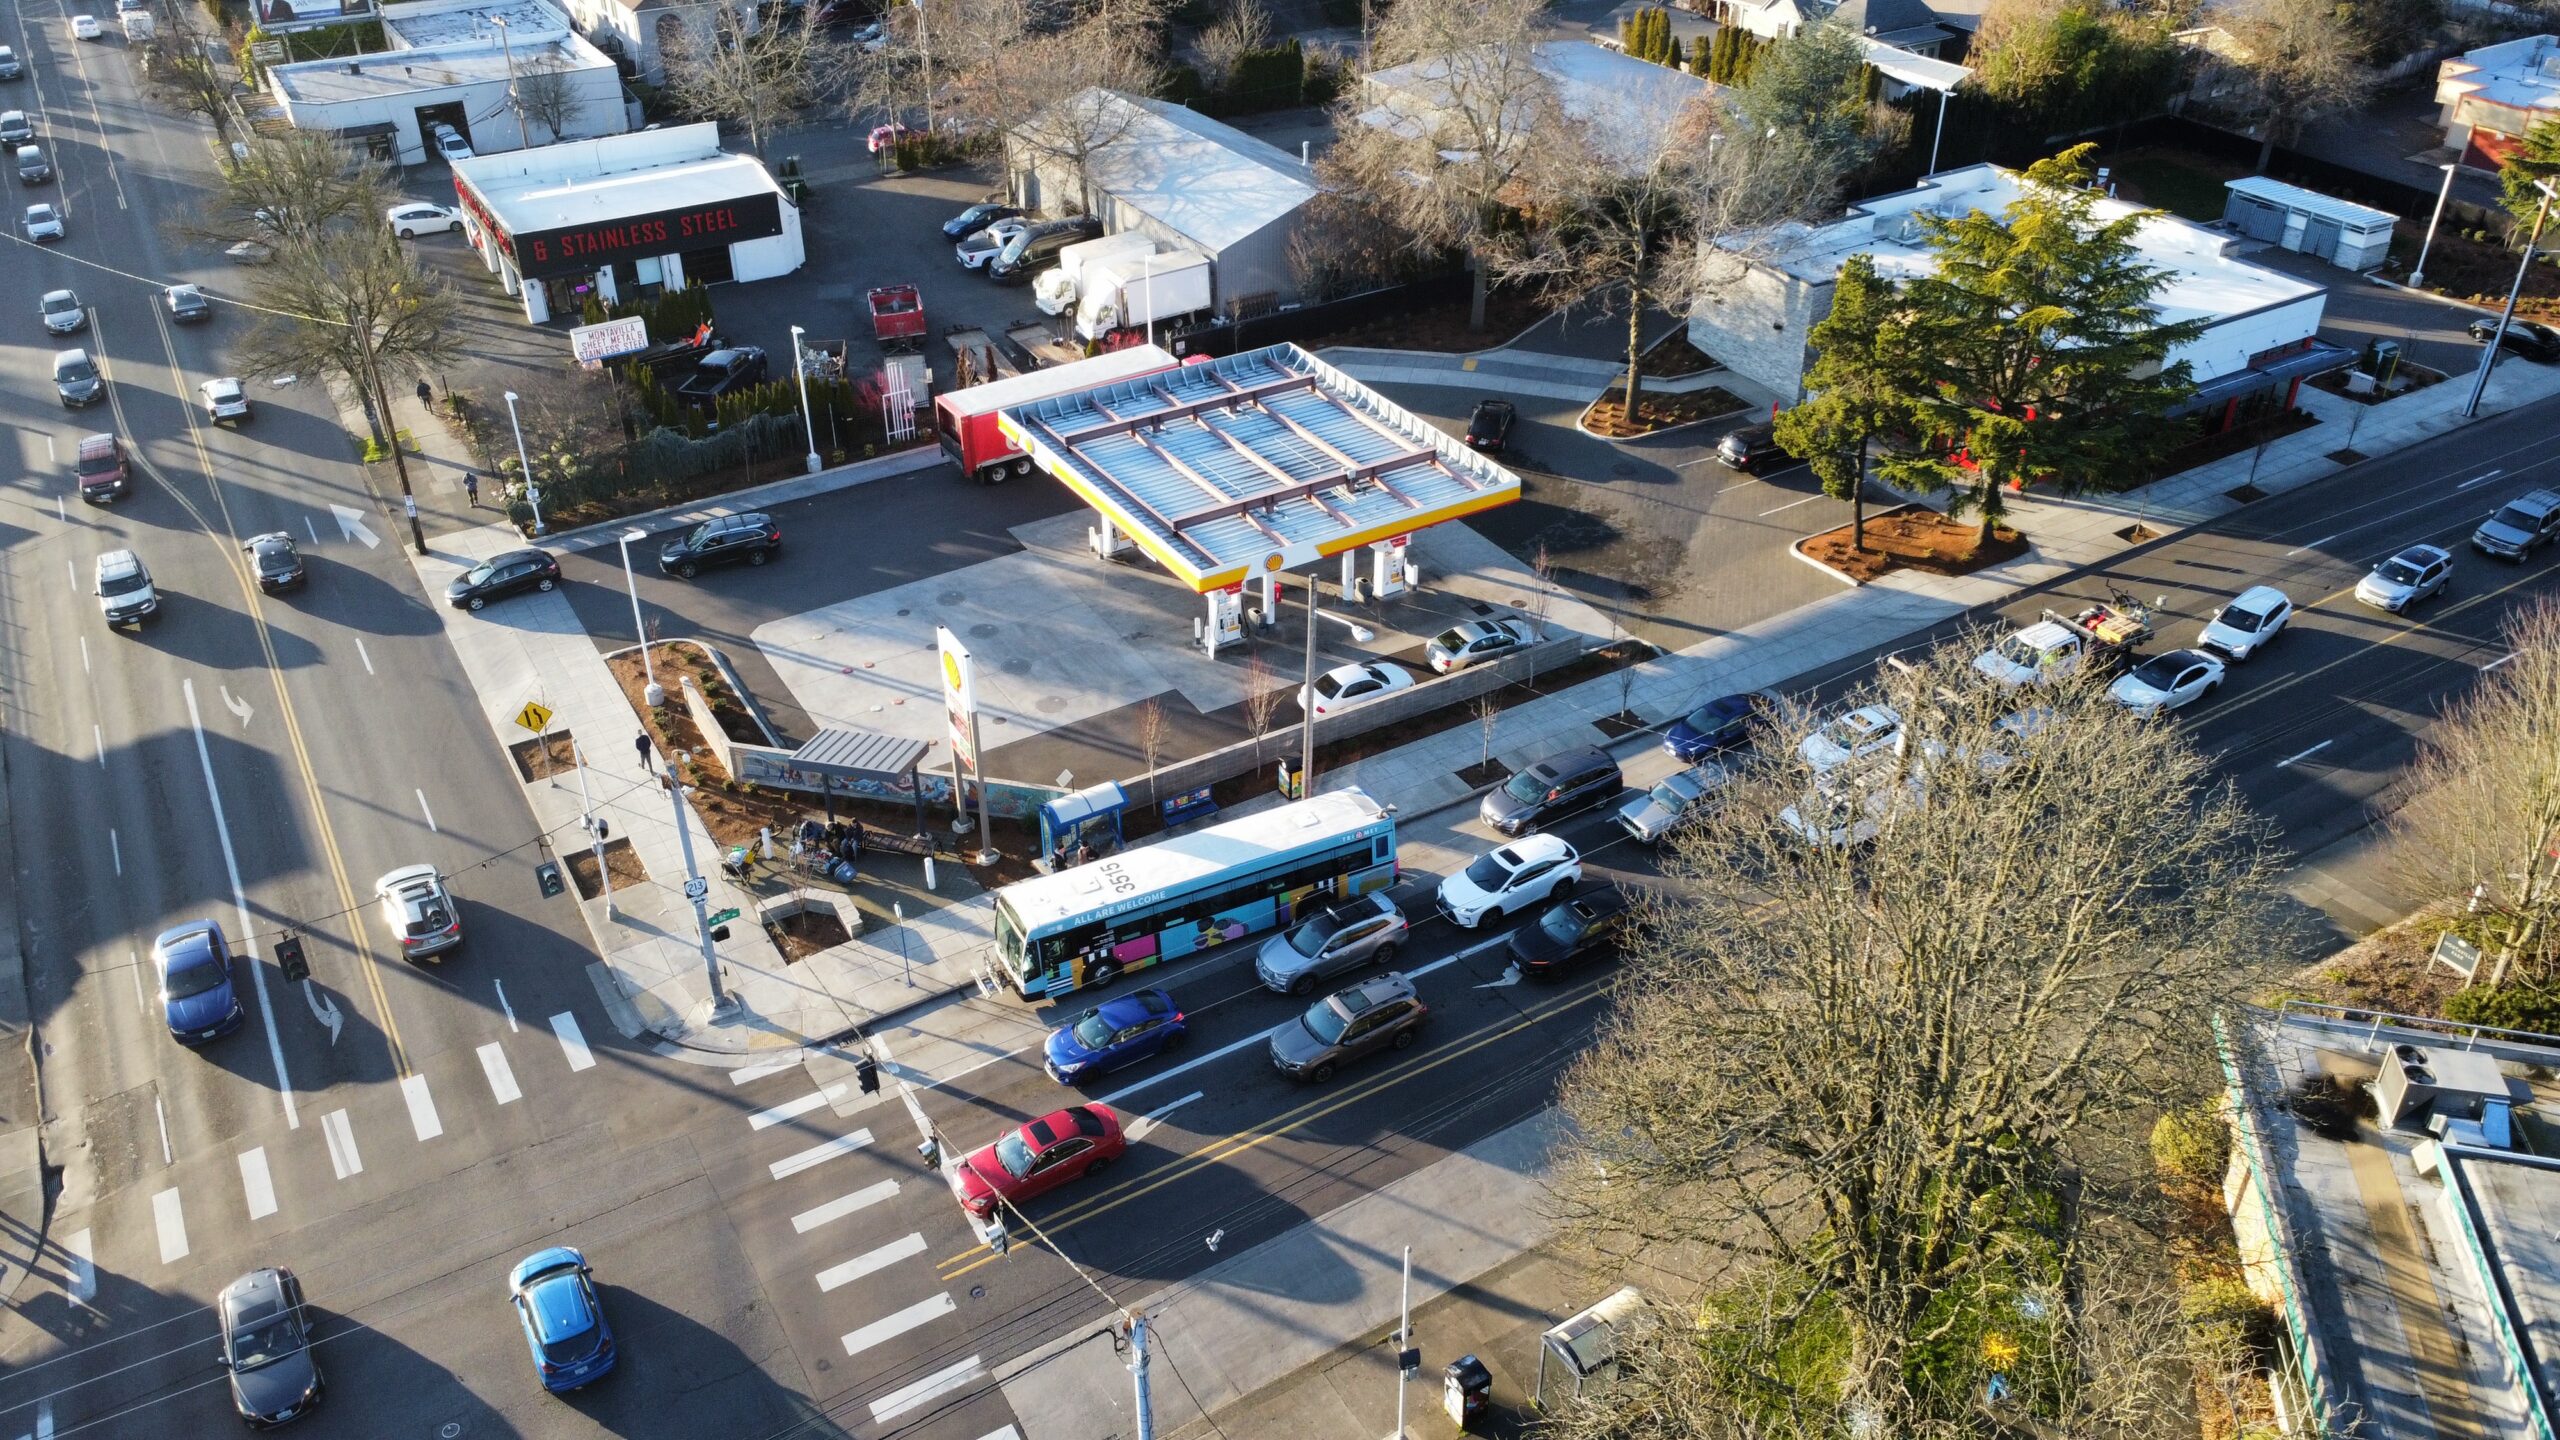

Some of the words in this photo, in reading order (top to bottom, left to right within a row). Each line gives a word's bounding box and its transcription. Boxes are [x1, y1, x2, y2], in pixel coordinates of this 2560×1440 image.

[533, 240, 548, 262] &
[561, 220, 667, 256] STAINLESS
[680, 208, 738, 236] STEEL
[582, 339, 606, 351] SHEET
[611, 333, 636, 345] METAL
[637, 330, 643, 339] &
[588, 323, 636, 340] MONTAVILLA
[579, 344, 621, 360] STAINLESS
[624, 339, 647, 351] STEEL
[687, 881, 704, 893] 213
[1100, 862, 1136, 894] 3515
[1074, 914, 1093, 926] ALL
[1095, 906, 1115, 919] ARE
[1117, 891, 1166, 911] WELCOME
